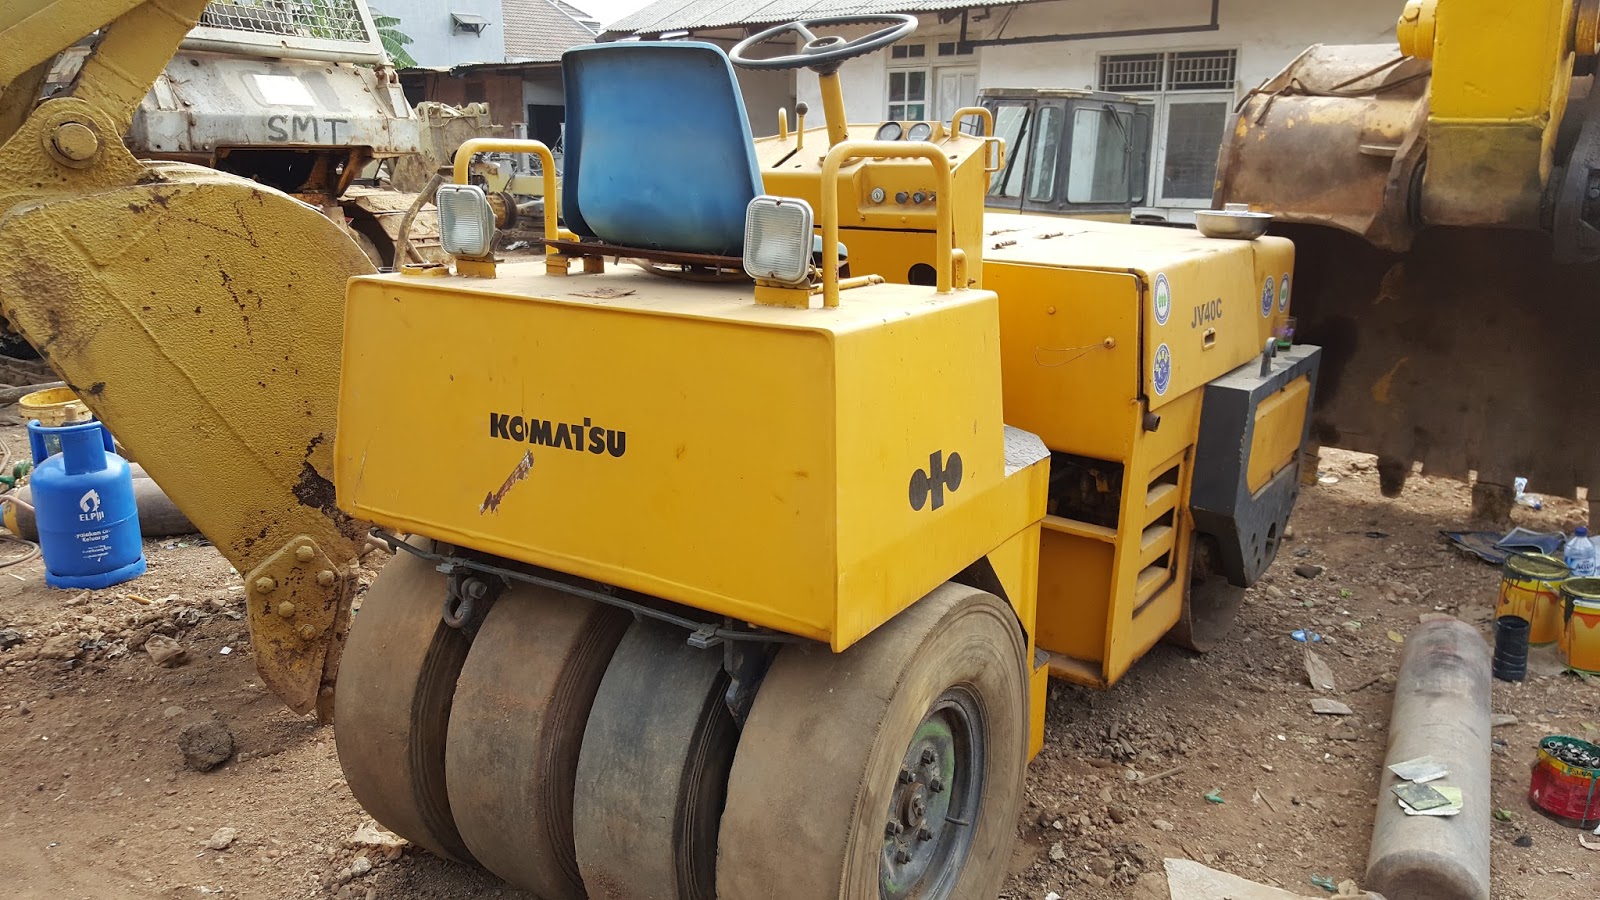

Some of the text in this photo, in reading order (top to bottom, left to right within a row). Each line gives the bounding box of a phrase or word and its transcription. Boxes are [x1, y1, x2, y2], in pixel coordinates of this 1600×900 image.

[267, 114, 348, 145] SMT
[1191, 298, 1222, 328] JV40C
[490, 412, 626, 458] KOMATSU
